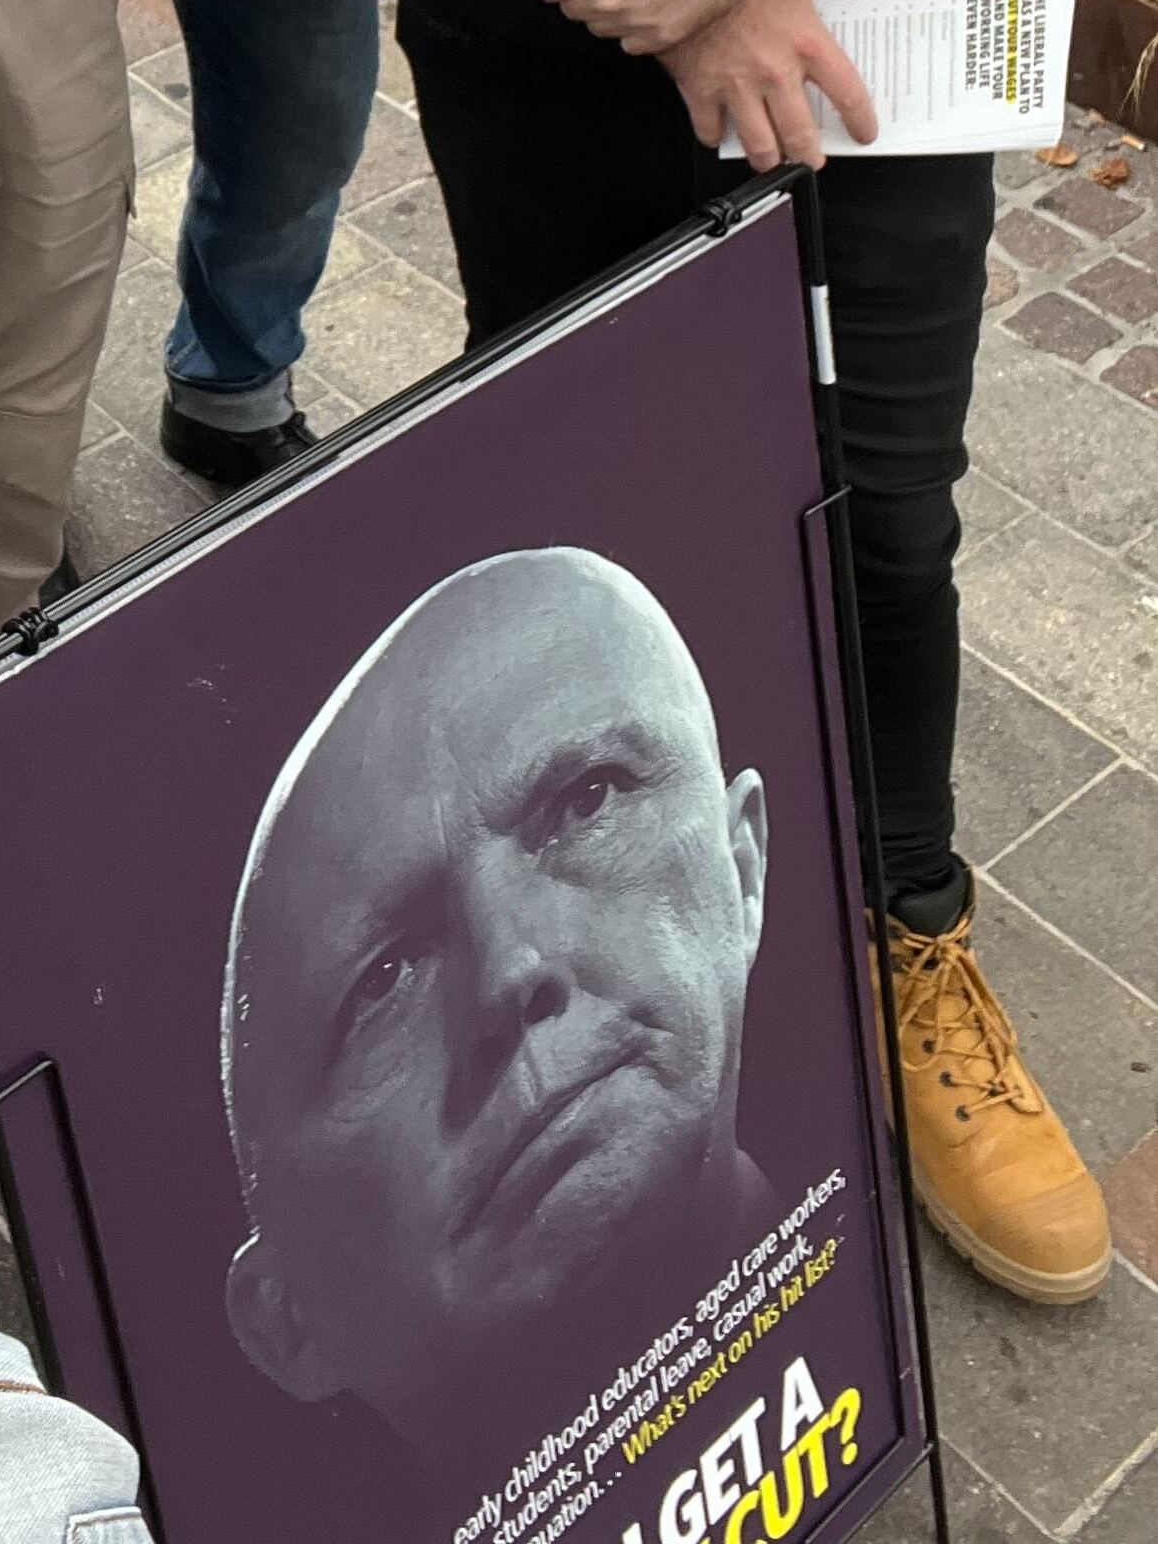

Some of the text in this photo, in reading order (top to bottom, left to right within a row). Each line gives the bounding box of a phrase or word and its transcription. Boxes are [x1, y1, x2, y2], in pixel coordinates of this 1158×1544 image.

[1007, 17, 1018, 53] YOUR
[1021, 19, 1032, 28] A
[1034, 15, 1046, 67] LIBERAL
[965, 33, 977, 91] HARDER:
[993, 25, 1005, 62] MAKE
[1021, 31, 1032, 58] NEW
[979, 62, 991, 89] LIFE
[992, 64, 1003, 101] YOUR
[1006, 56, 1017, 101] WAGES
[1020, 63, 1031, 96] PLAN
[1033, 70, 1045, 109] PARTY
[1019, 98, 1031, 114] TO
[453, 1168, 847, 1544] early childhood educators, aged care workers,
[622, 1394, 687, 1464] What's
[688, 1351, 728, 1405] next
[728, 1330, 753, 1364] on
[753, 1302, 780, 1338] his
[779, 1275, 806, 1312] hit
[803, 1238, 838, 1288] list?
[492, 1234, 814, 1544] students, parental leave, casual work,
[658, 1356, 825, 1544] GET A
[724, 1387, 861, 1544] CUT?
